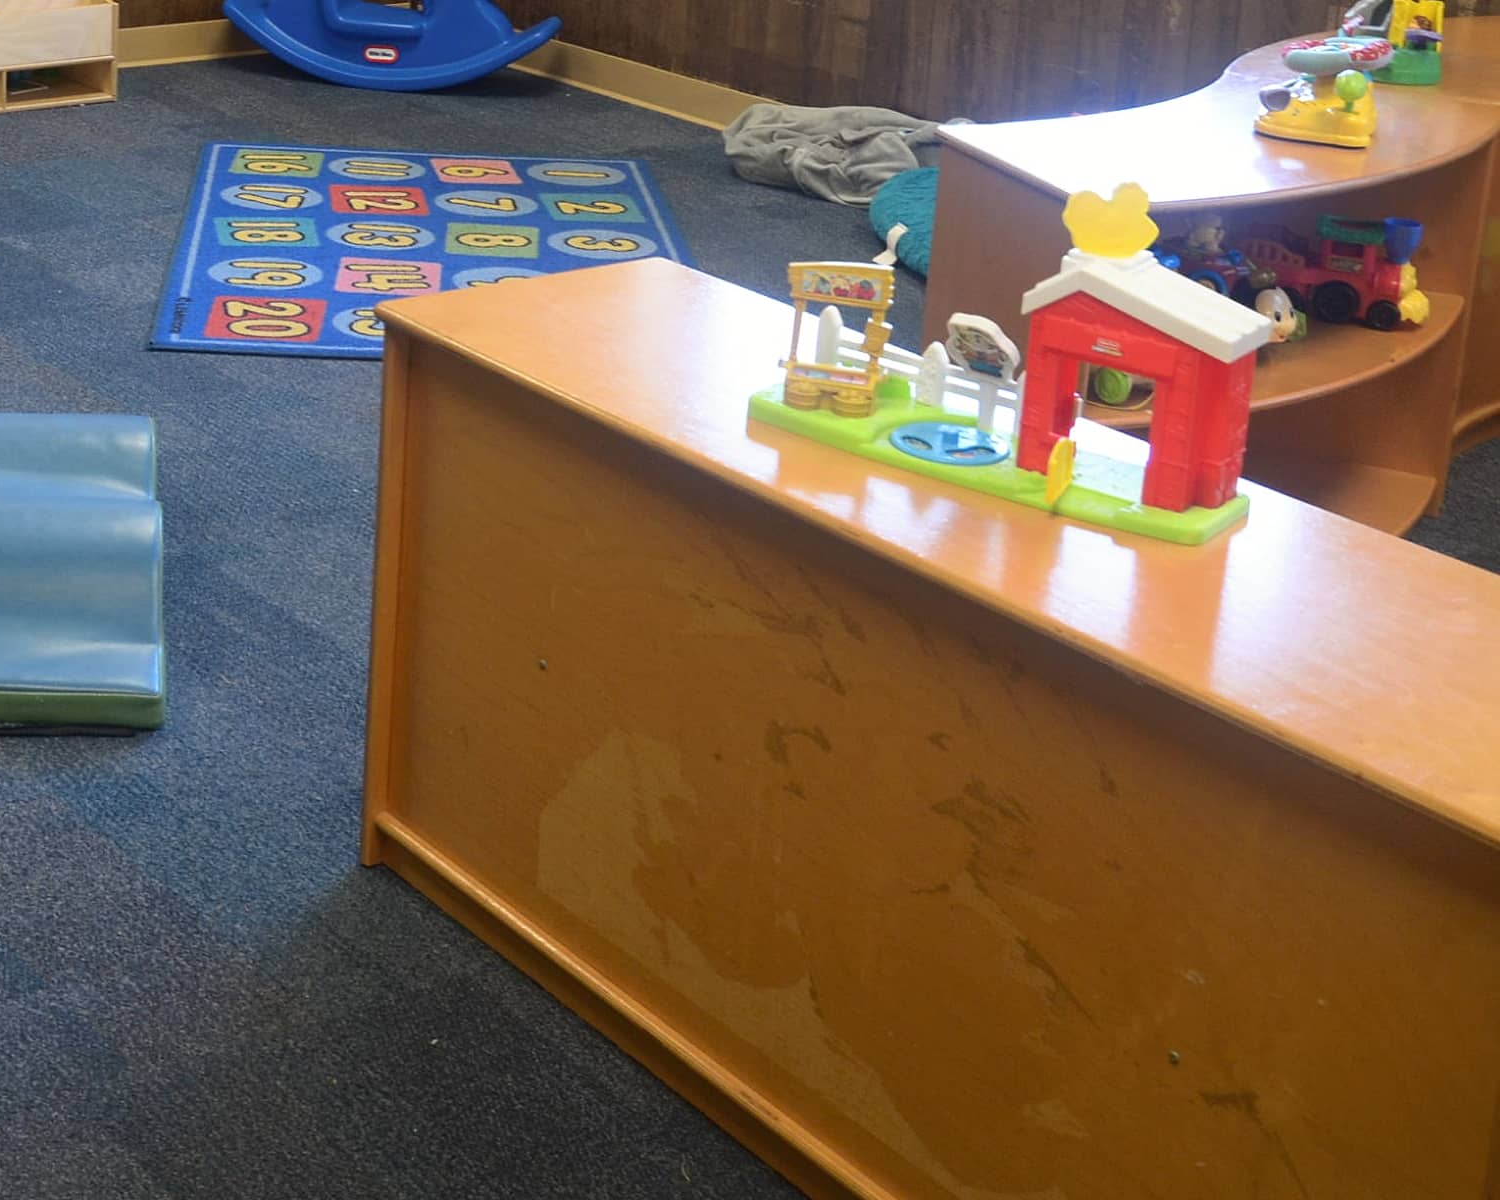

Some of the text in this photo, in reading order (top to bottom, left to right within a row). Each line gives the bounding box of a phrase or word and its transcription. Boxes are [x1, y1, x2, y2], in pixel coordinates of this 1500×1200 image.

[242, 154, 313, 174] 16
[343, 160, 412, 177] 11
[440, 165, 510, 178] 6
[543, 169, 611, 178] 1
[235, 185, 309, 209] 17
[343, 191, 419, 211] 12
[446, 196, 518, 212] 7
[555, 200, 629, 215] 2
[228, 220, 306, 243] 18
[341, 223, 421, 247] 13
[455, 232, 532, 249] 8
[564, 235, 640, 253] 3
[224, 260, 308, 287] 19
[345, 263, 432, 291] 14
[223, 300, 311, 338] 20
